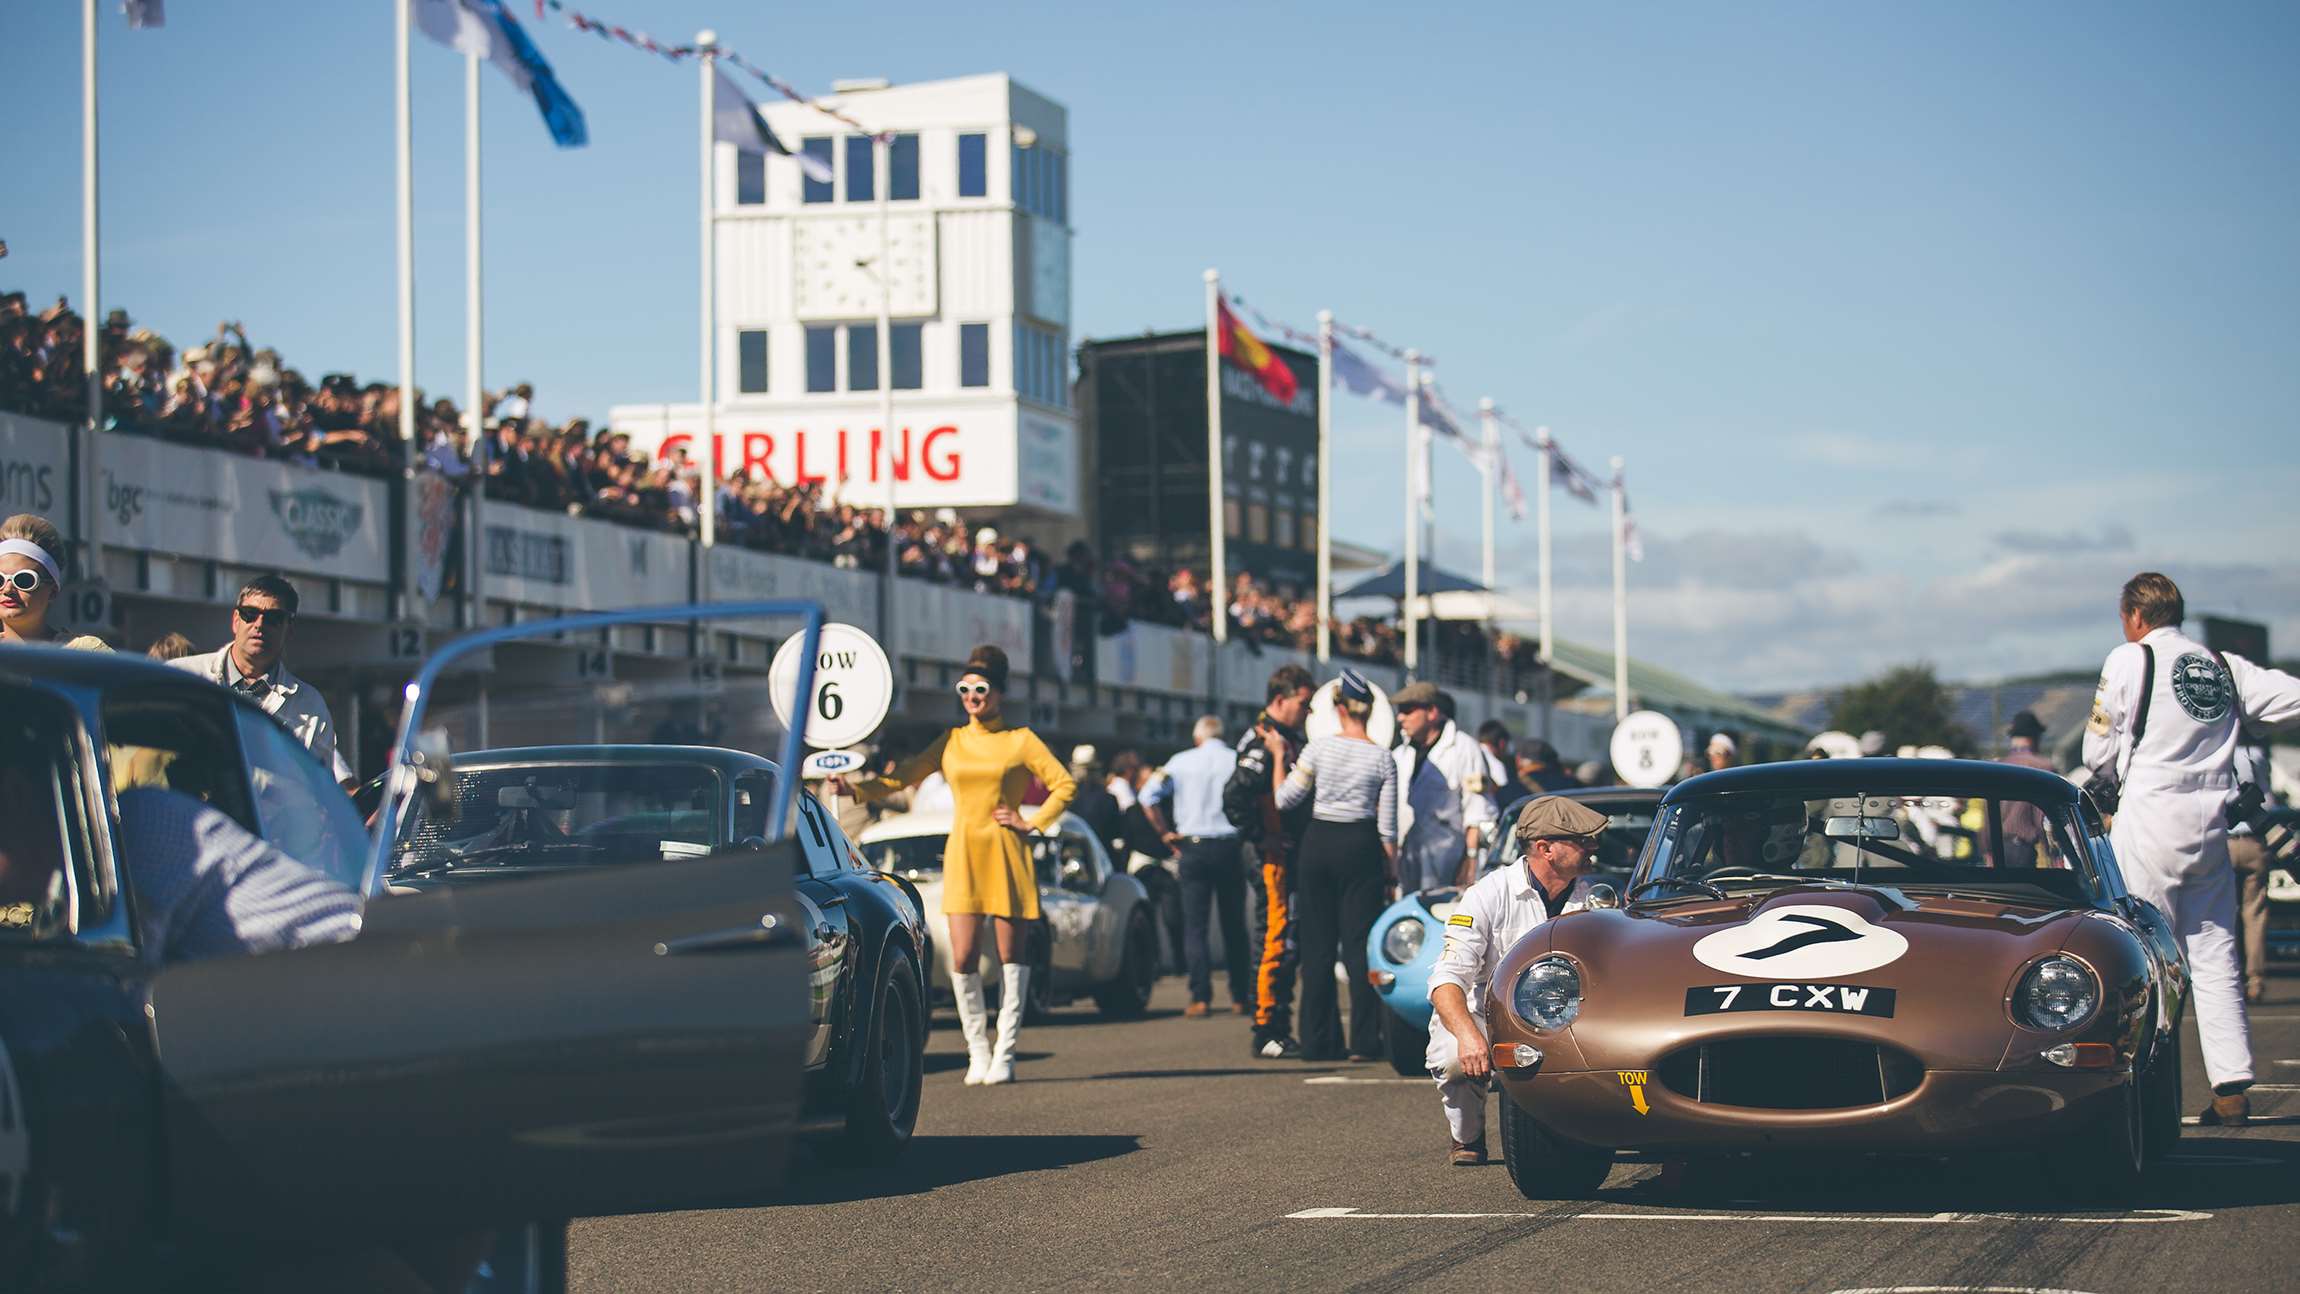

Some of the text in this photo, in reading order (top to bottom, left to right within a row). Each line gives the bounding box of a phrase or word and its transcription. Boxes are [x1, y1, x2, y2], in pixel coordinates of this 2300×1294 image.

[0, 461, 53, 512] ms
[818, 682, 843, 720] 6
[1735, 914, 1865, 960] 7
[1713, 985, 1869, 1011] 7 CXW
[1616, 1071, 1647, 1085] TOW
